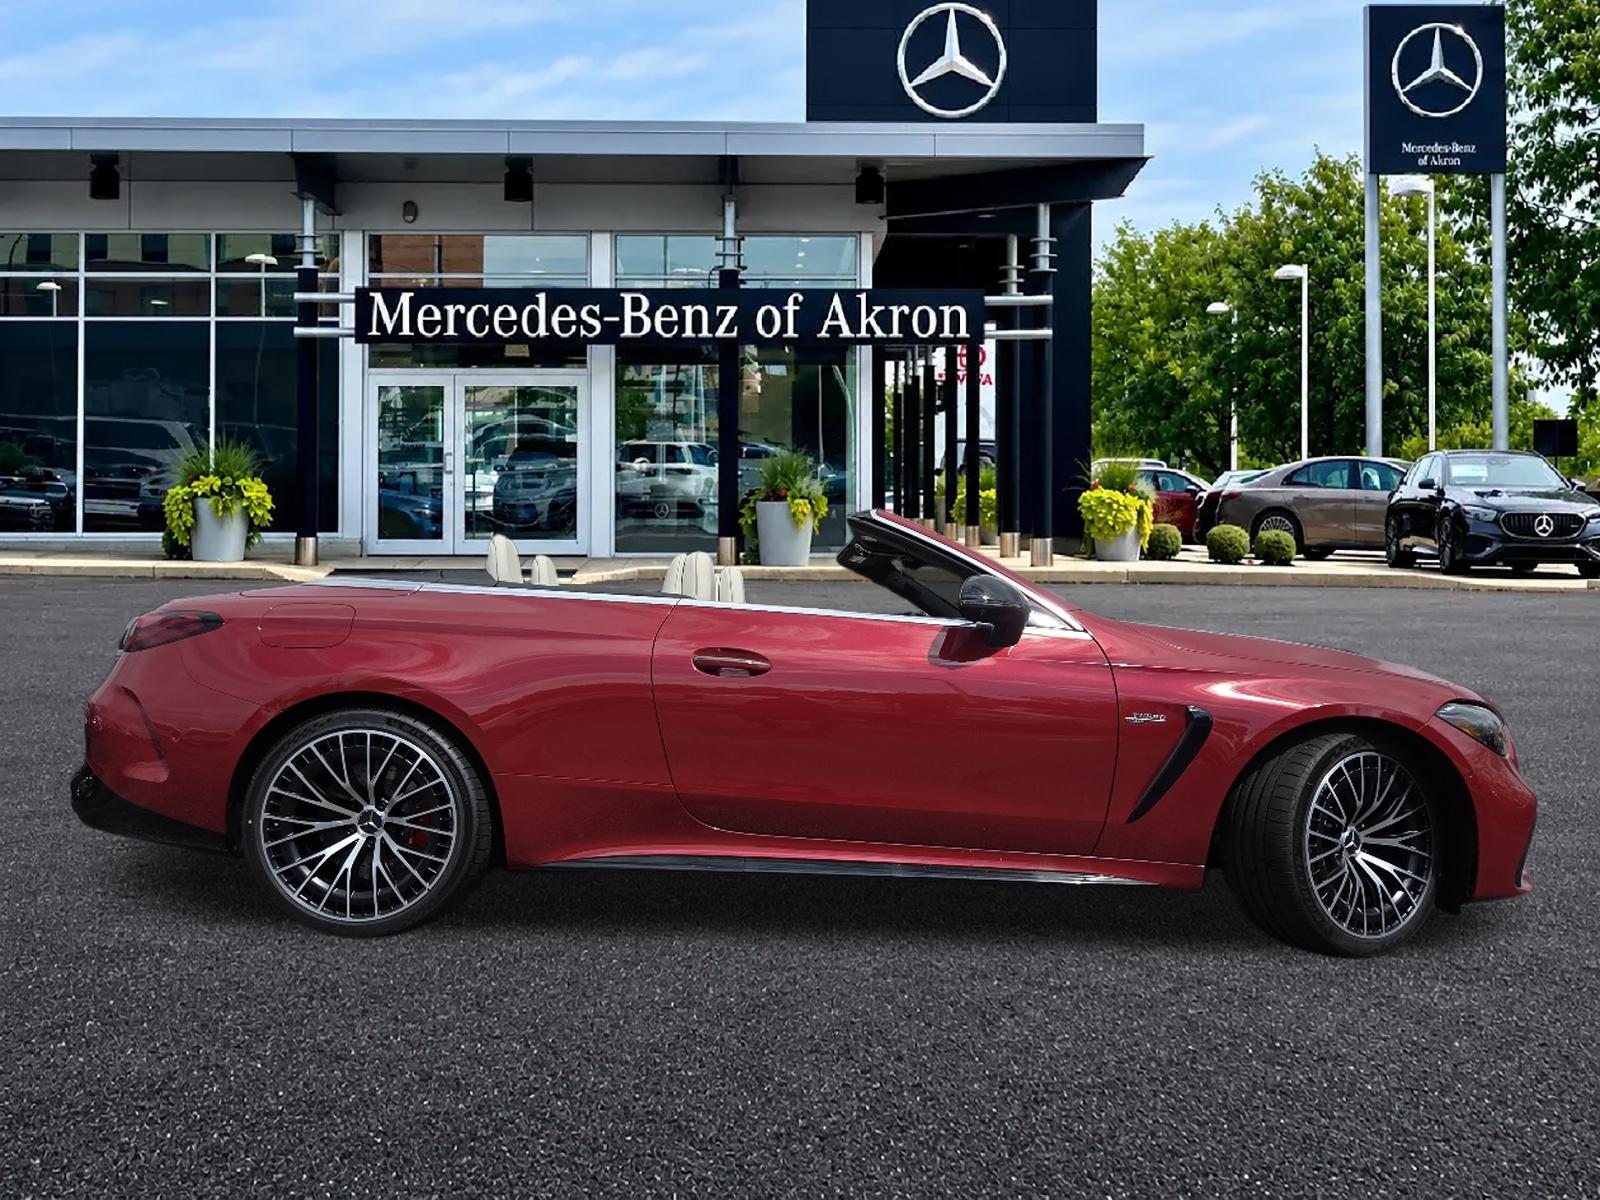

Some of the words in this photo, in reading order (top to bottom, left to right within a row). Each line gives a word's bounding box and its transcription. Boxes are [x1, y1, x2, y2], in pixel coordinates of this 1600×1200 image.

[1401, 141, 1477, 154] Mercedes-Benz
[1417, 154, 1429, 166] of
[1430, 154, 1461, 166] Akron
[368, 291, 738, 339] Mercedes-Benz
[756, 292, 804, 338] of
[817, 292, 970, 338] Akron
